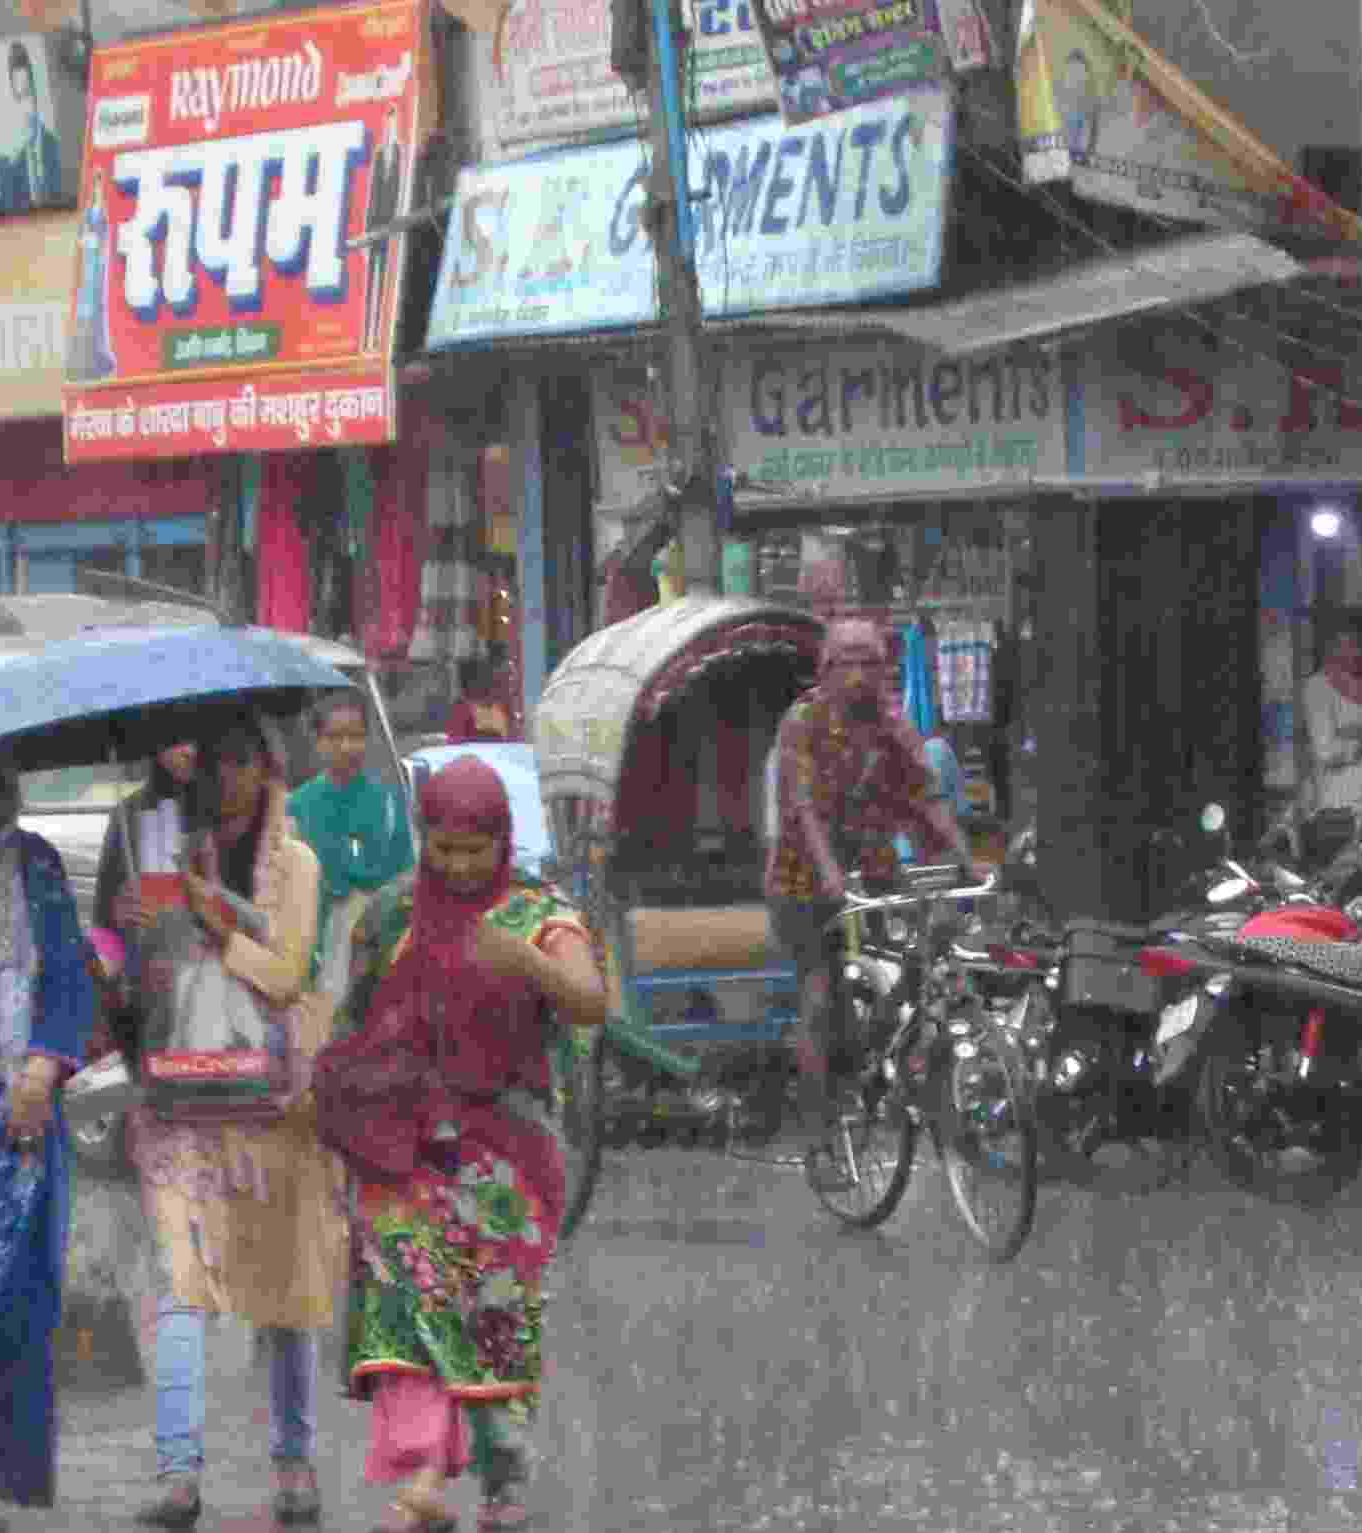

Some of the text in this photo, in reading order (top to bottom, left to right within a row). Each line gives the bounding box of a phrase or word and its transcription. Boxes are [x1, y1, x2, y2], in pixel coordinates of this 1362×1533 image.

[170, 40, 323, 132] Raymond
[608, 112, 912, 258] GRMENTS
[749, 350, 1050, 437] Garments
